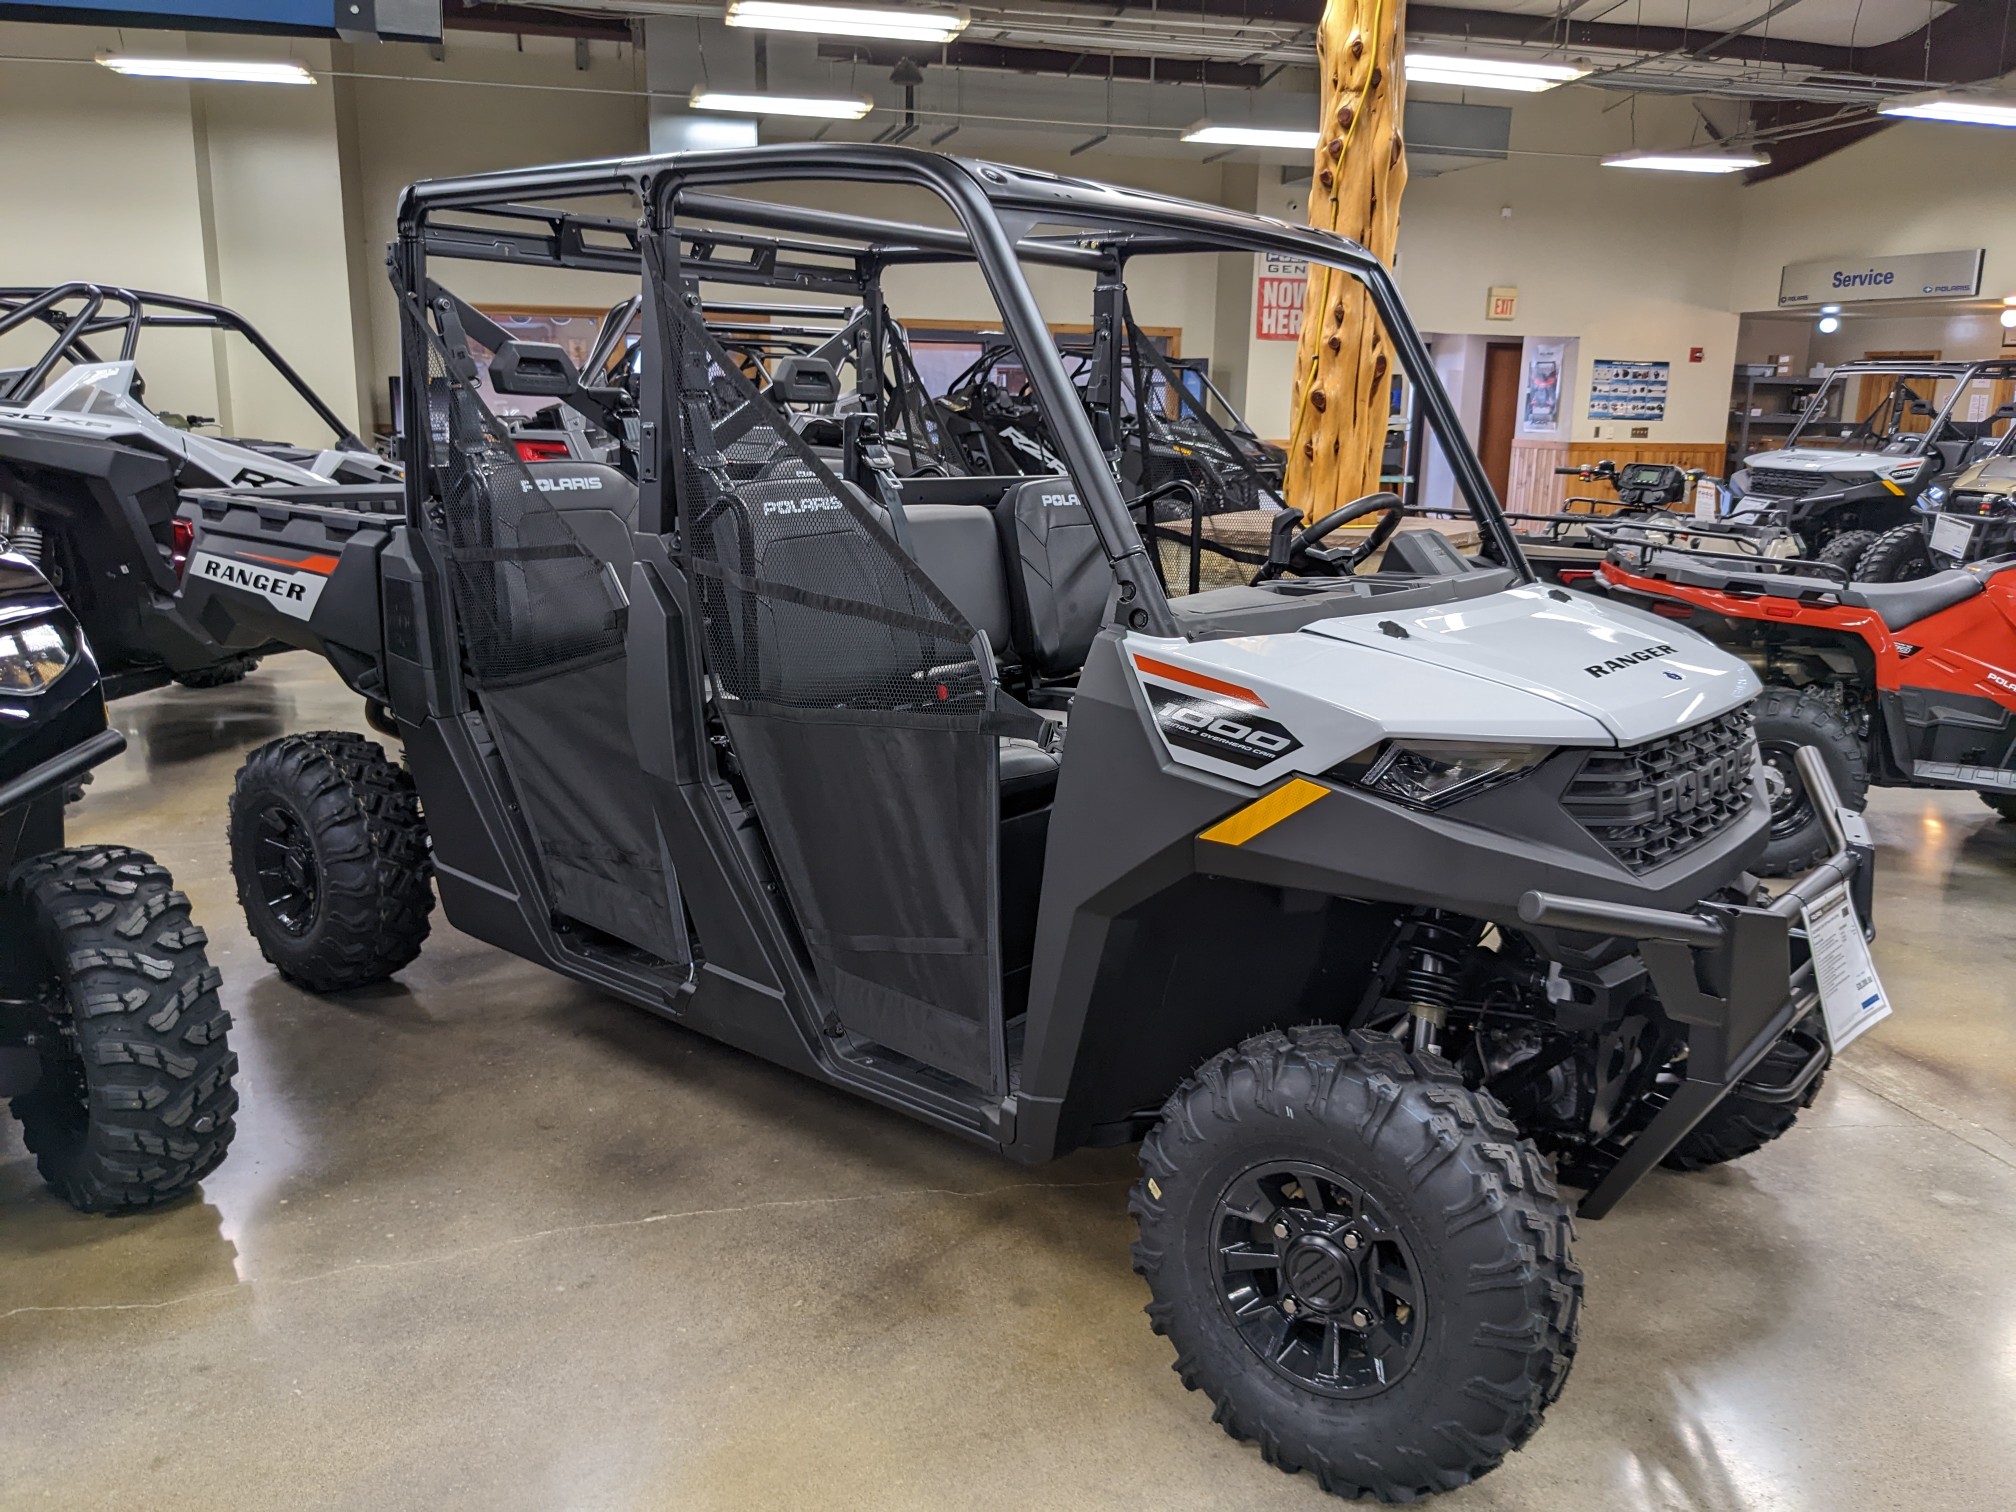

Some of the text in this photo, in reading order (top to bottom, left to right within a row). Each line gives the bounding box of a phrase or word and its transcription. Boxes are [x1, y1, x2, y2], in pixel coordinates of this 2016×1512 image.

[1268, 264, 1306, 274] GEN
[1832, 268, 1895, 288] Service
[1494, 298, 1515, 316] EXIT
[1261, 308, 1303, 334] HER
[520, 477, 603, 493] POLARIS
[763, 495, 844, 516] POLARIS
[1041, 494, 1081, 507] POLA
[204, 560, 307, 602] RANGER
[1584, 644, 1679, 678] RANGER
[1158, 702, 1292, 751] 1000
[1200, 731, 1253, 751] OVERHEAD
[1252, 748, 1277, 759] CAM
